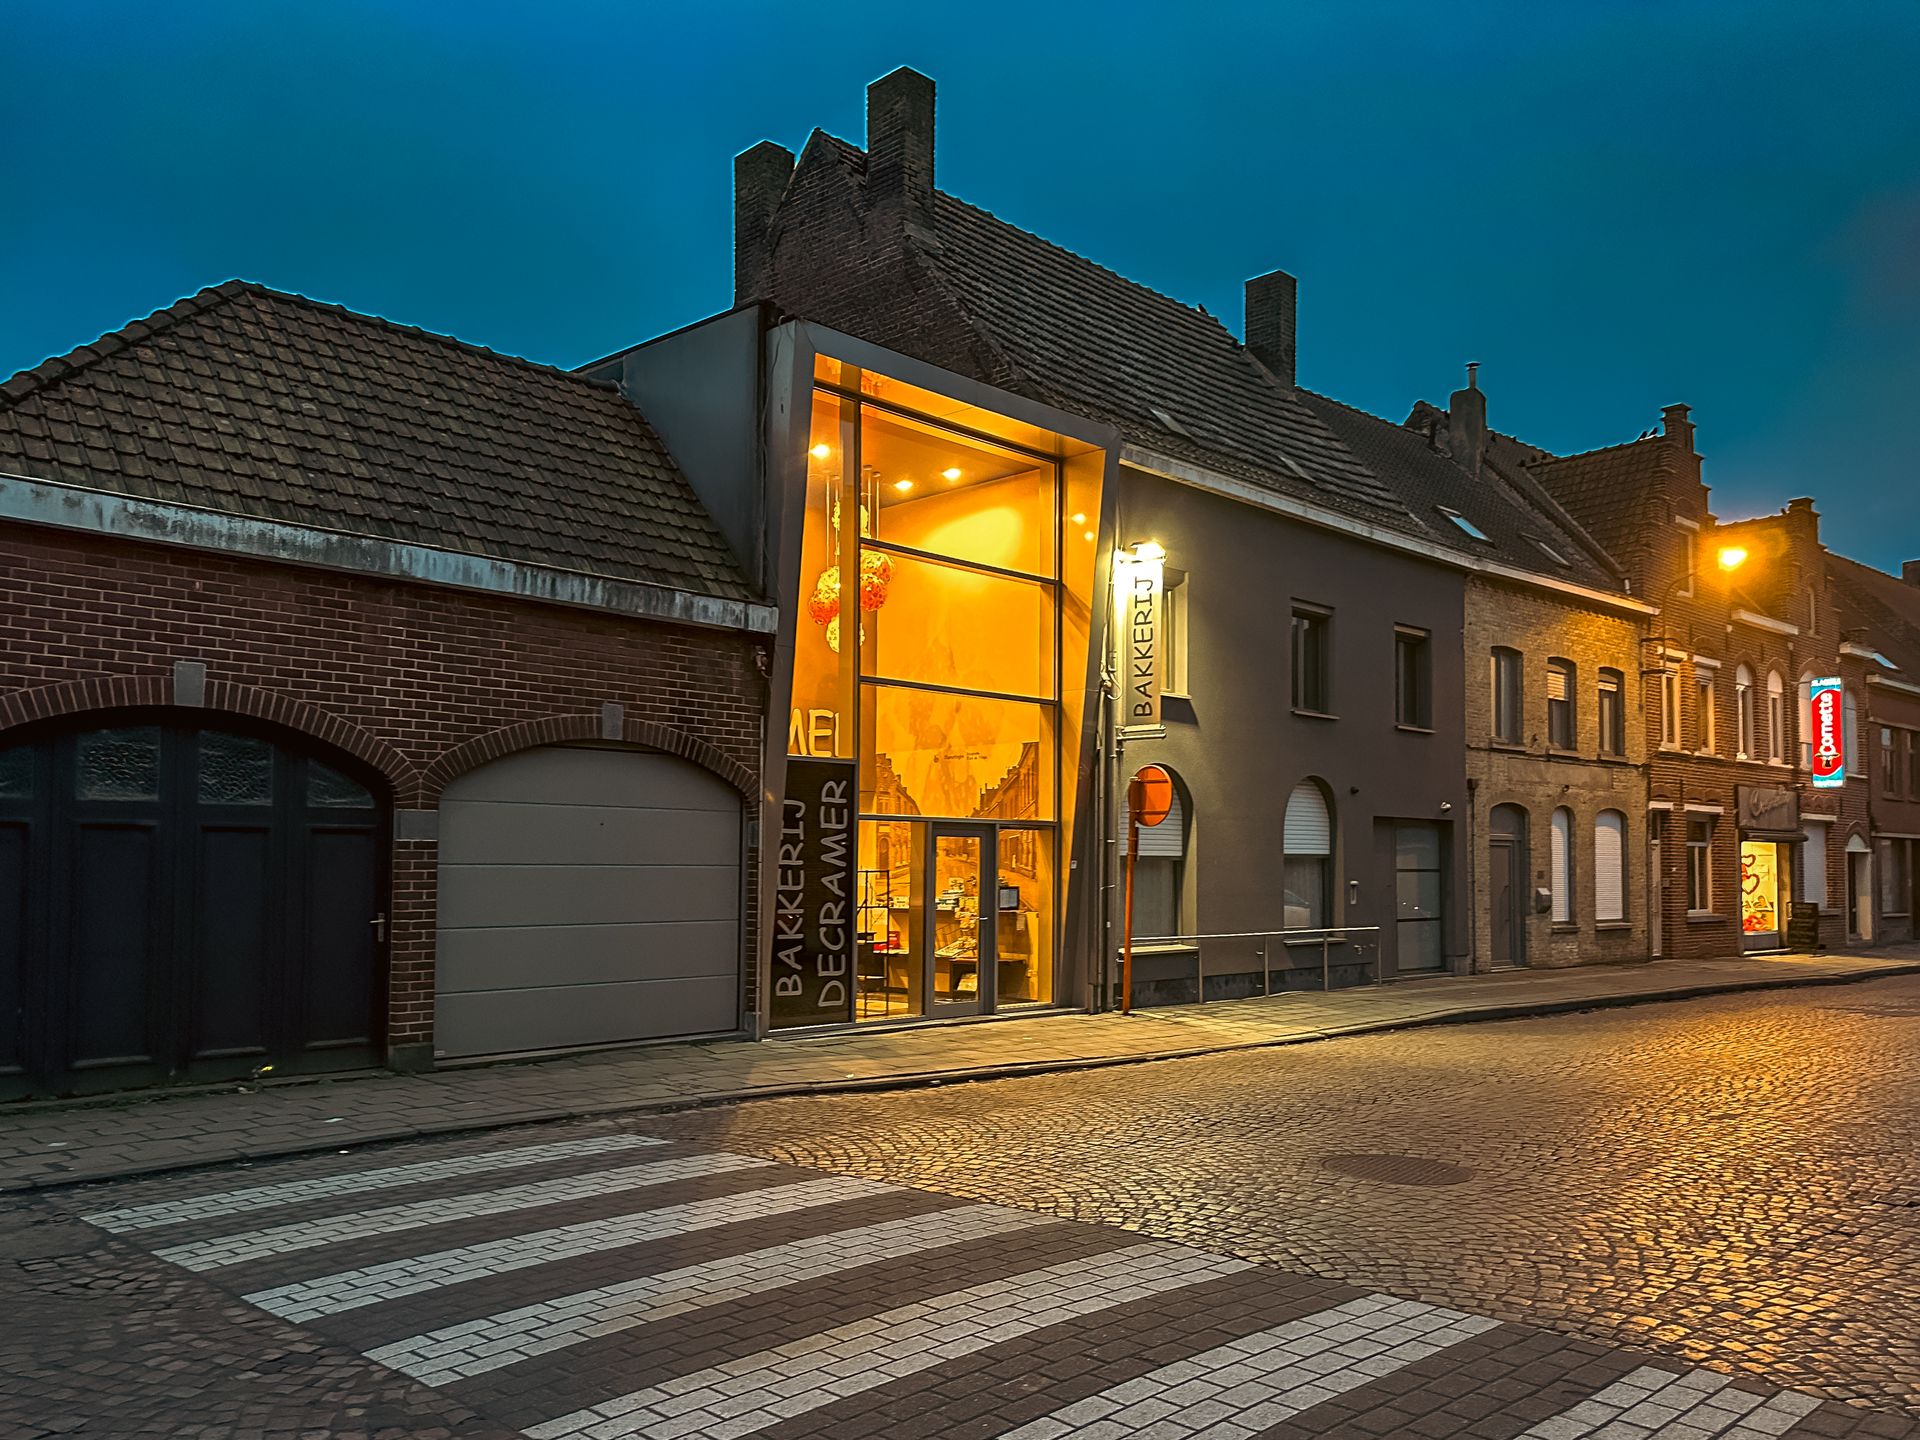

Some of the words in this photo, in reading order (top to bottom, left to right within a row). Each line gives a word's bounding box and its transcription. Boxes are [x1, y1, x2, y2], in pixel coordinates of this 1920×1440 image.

[1133, 576, 1153, 716] BAKKERIJ
[776, 799, 806, 997] BAKKERIJ
[817, 780, 849, 1008] DECRAMER
